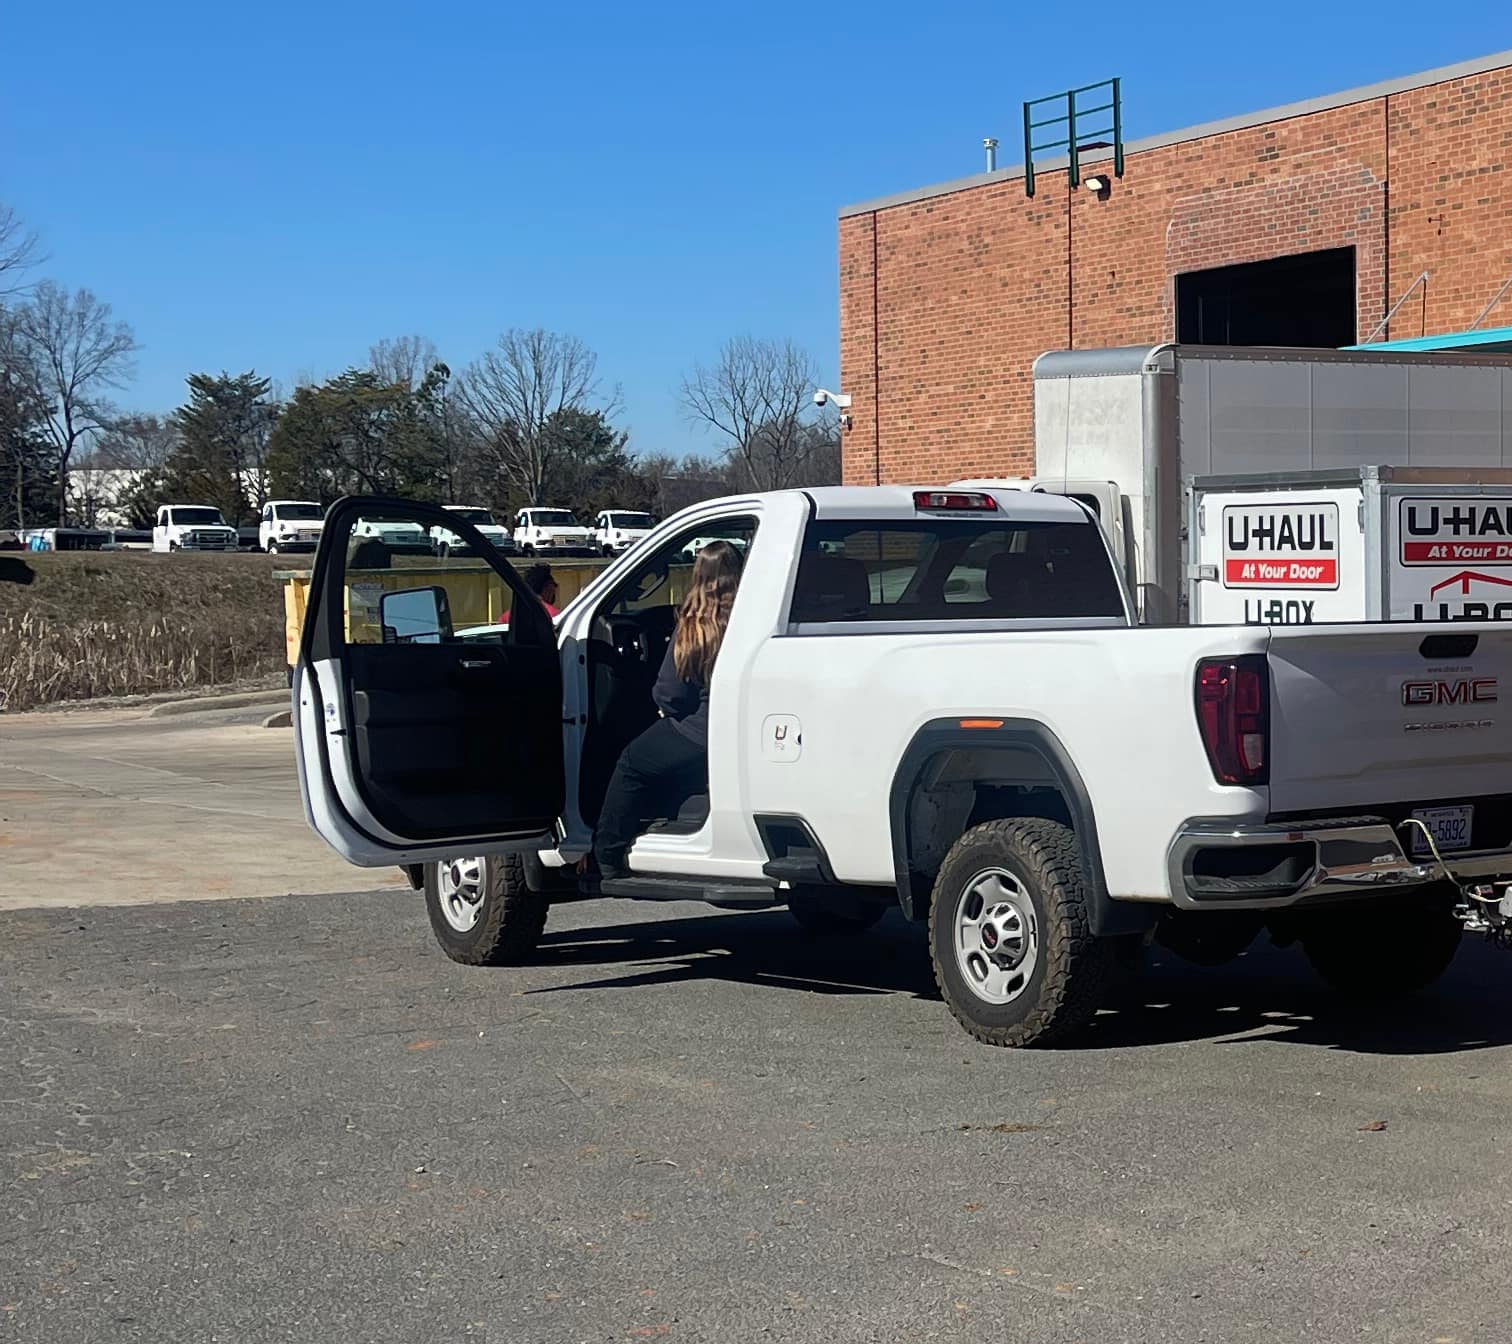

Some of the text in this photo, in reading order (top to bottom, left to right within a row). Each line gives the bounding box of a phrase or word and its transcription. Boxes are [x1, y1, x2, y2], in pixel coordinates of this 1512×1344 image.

[1228, 514, 1334, 551] U-HAUL
[1428, 545, 1447, 558] At
[1453, 545, 1491, 558] Your
[1241, 564, 1324, 579] At Your Door
[1401, 677, 1498, 706] GMC
